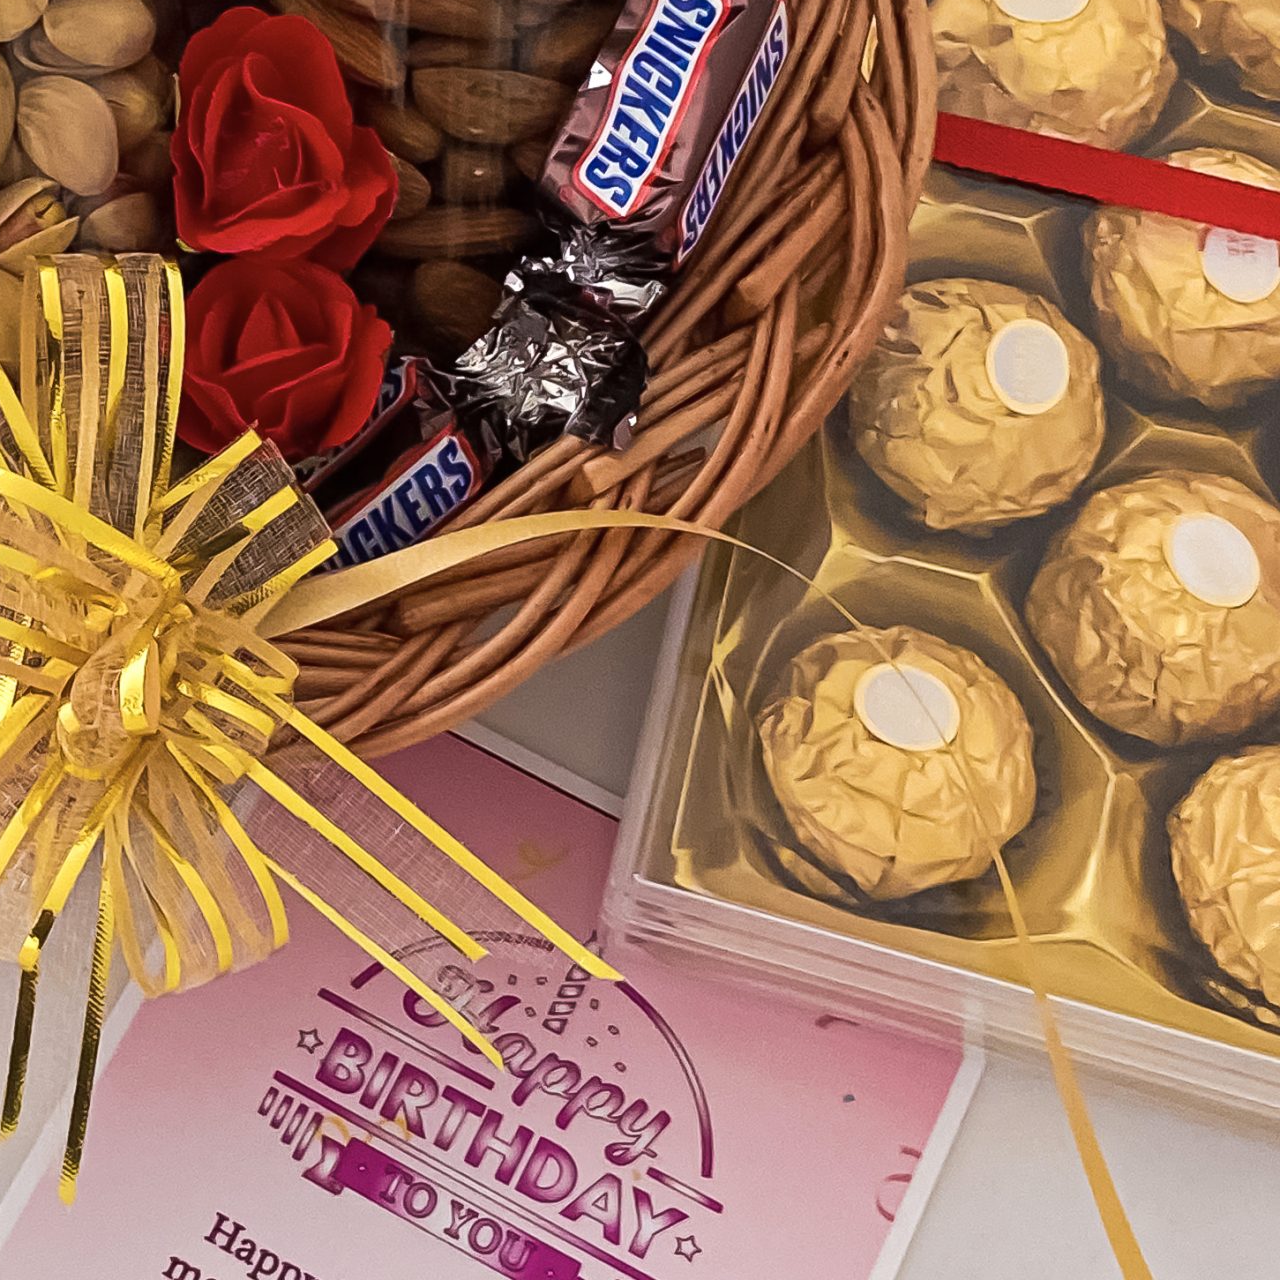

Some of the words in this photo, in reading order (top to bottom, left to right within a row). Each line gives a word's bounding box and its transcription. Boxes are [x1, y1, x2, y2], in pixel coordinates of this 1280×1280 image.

[682, 15, 784, 253] SNICKERS
[315, 1027, 690, 1259] BIRTHDAY
[379, 1165, 439, 1219] TO
[443, 1198, 539, 1271] YOU
[204, 1211, 321, 1280] Happ
